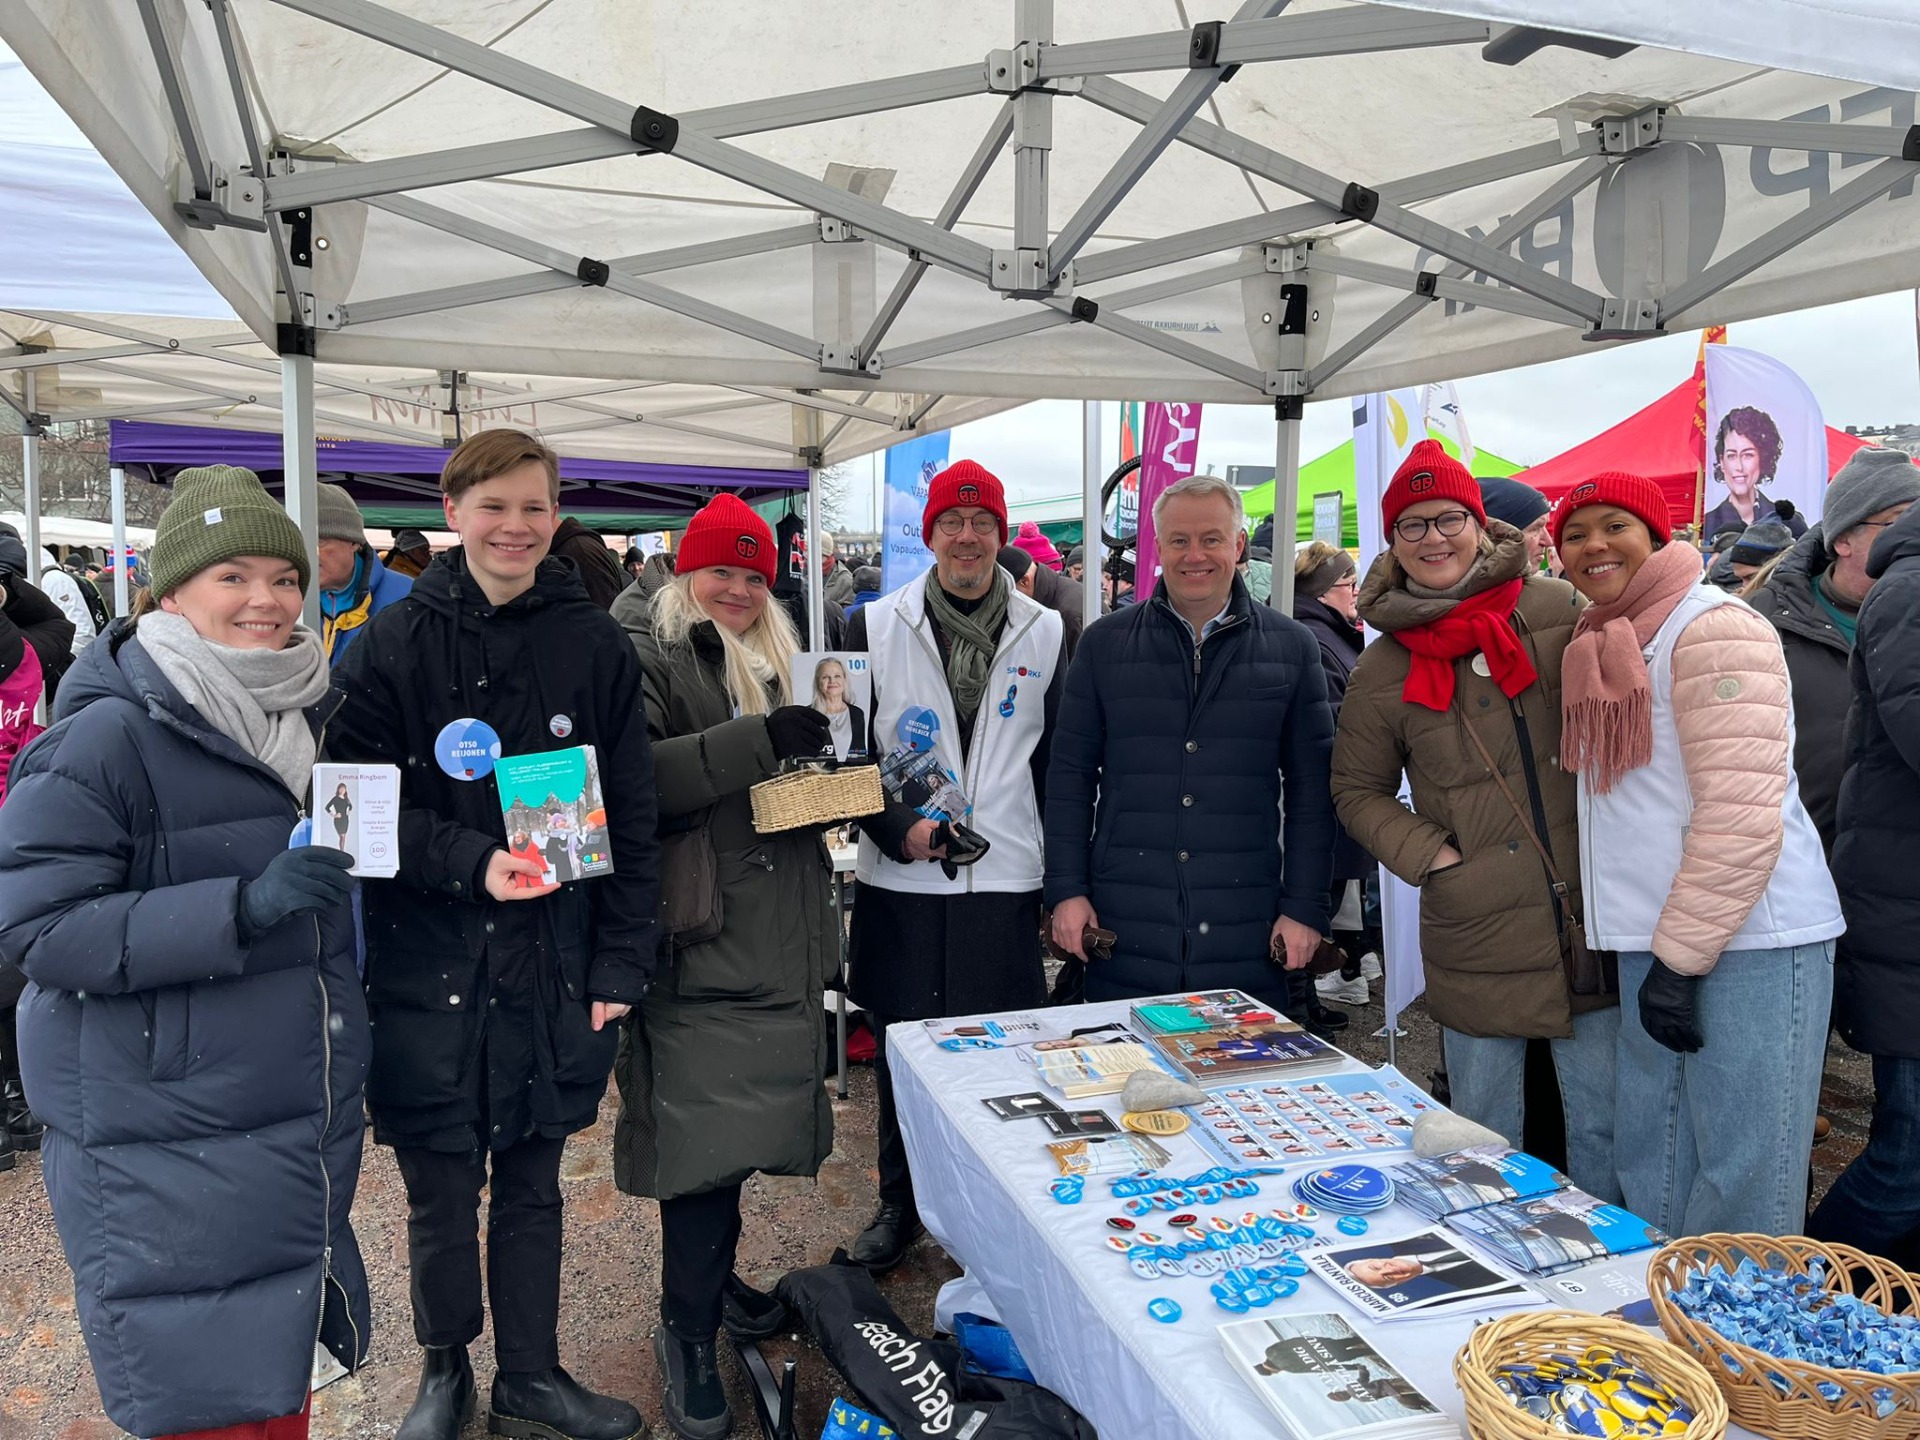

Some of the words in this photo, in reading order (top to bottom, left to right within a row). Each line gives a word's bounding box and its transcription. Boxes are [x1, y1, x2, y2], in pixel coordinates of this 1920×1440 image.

[848, 659, 866, 670] 101
[451, 749, 486, 757] REIJONEN
[458, 741, 477, 749] OTSO
[1309, 1253, 1355, 1287] RANTALA
[1561, 1281, 1583, 1293] 87
[1599, 1273, 1638, 1297] Silja
[1346, 1280, 1392, 1313] MARCUS
[1293, 1346, 1311, 1365] DIG
[900, 1360, 955, 1435] Flag
